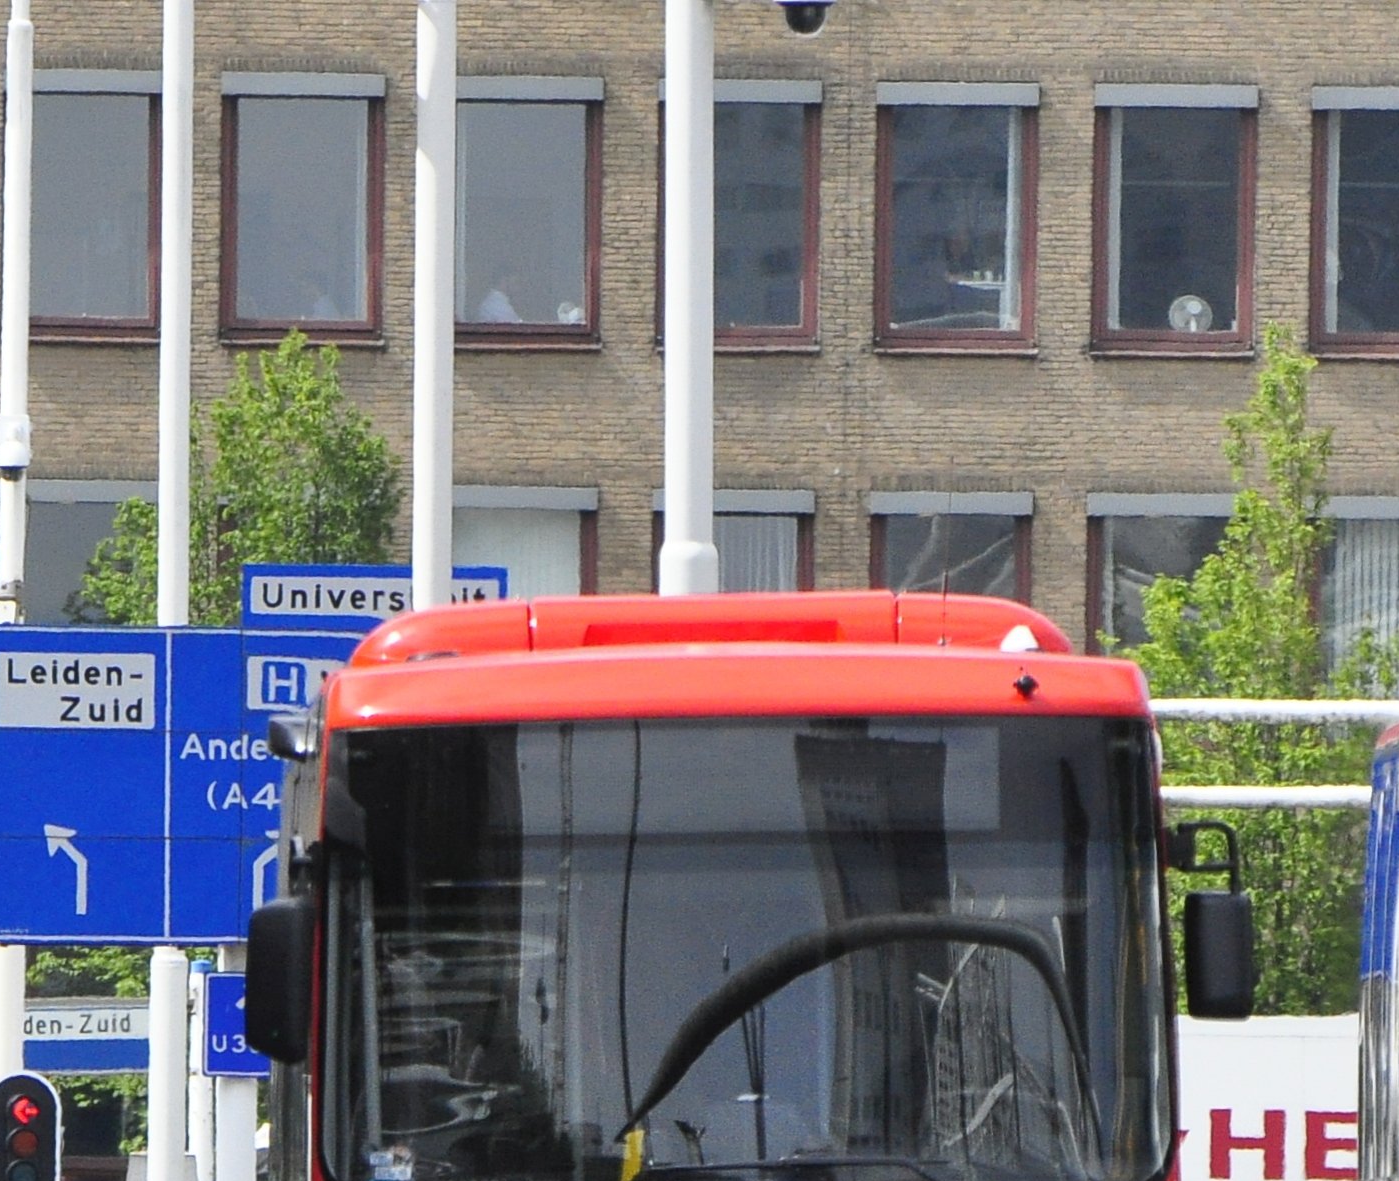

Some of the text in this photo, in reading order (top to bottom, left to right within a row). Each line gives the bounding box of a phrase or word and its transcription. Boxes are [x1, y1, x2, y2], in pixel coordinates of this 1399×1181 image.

[7, 658, 143, 687] Leiden-
[59, 696, 143, 723] Zuid
[179, 732, 282, 761] Ande
[206, 780, 285, 811] (A4
[22, 1013, 131, 1035] den-Zuid
[1178, 1108, 1358, 1181] HE
